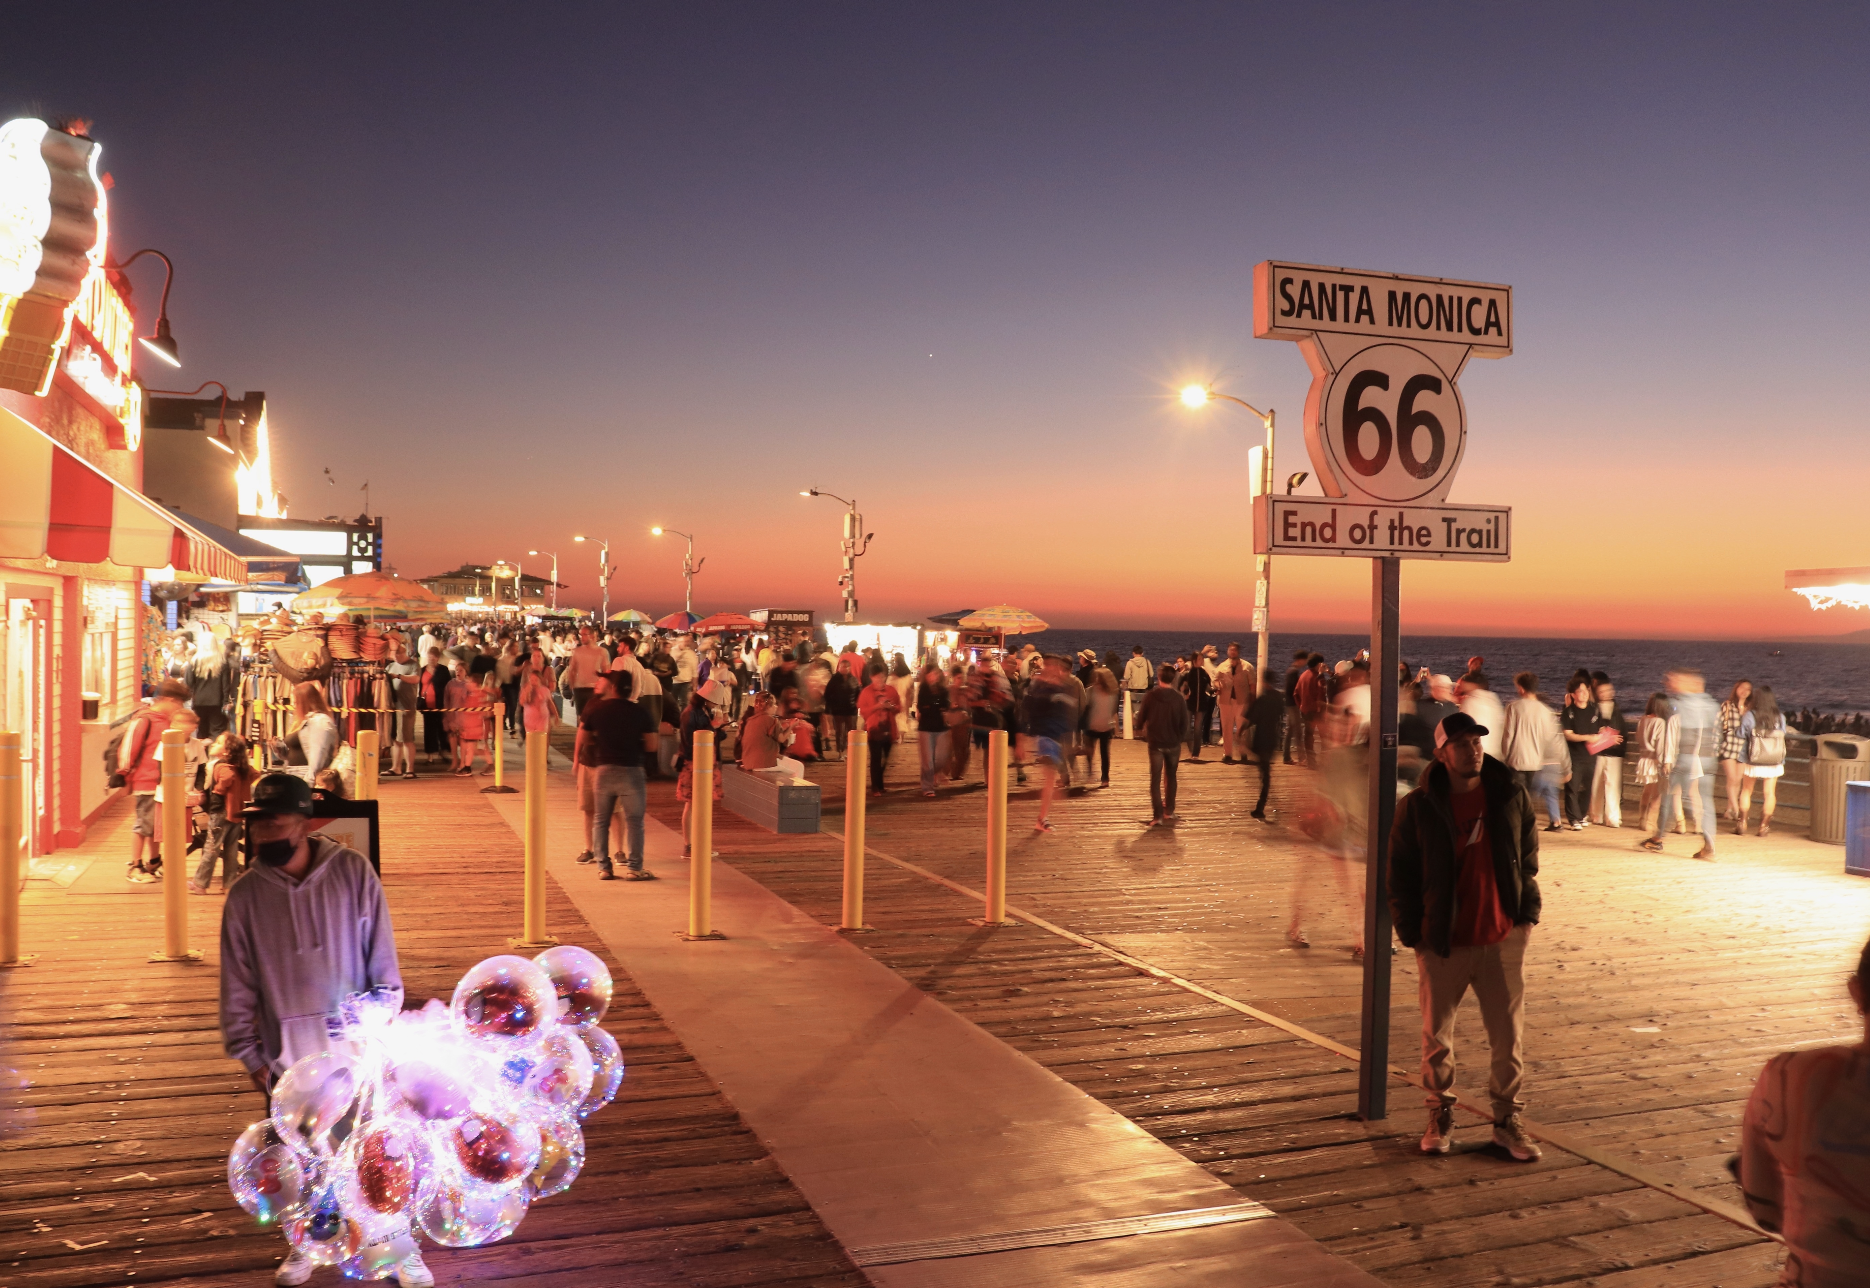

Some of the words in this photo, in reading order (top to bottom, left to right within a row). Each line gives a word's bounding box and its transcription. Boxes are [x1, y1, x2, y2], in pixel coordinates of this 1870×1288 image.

[1279, 277, 1375, 325] SANTA
[1387, 290, 1503, 337] MONICA
[1342, 369, 1445, 480] 66
[1282, 508, 1338, 544] End
[1348, 510, 1379, 545] of
[1388, 512, 1433, 548] the
[1442, 515, 1500, 549] Trail
[771, 613, 809, 621] JAPADOG
